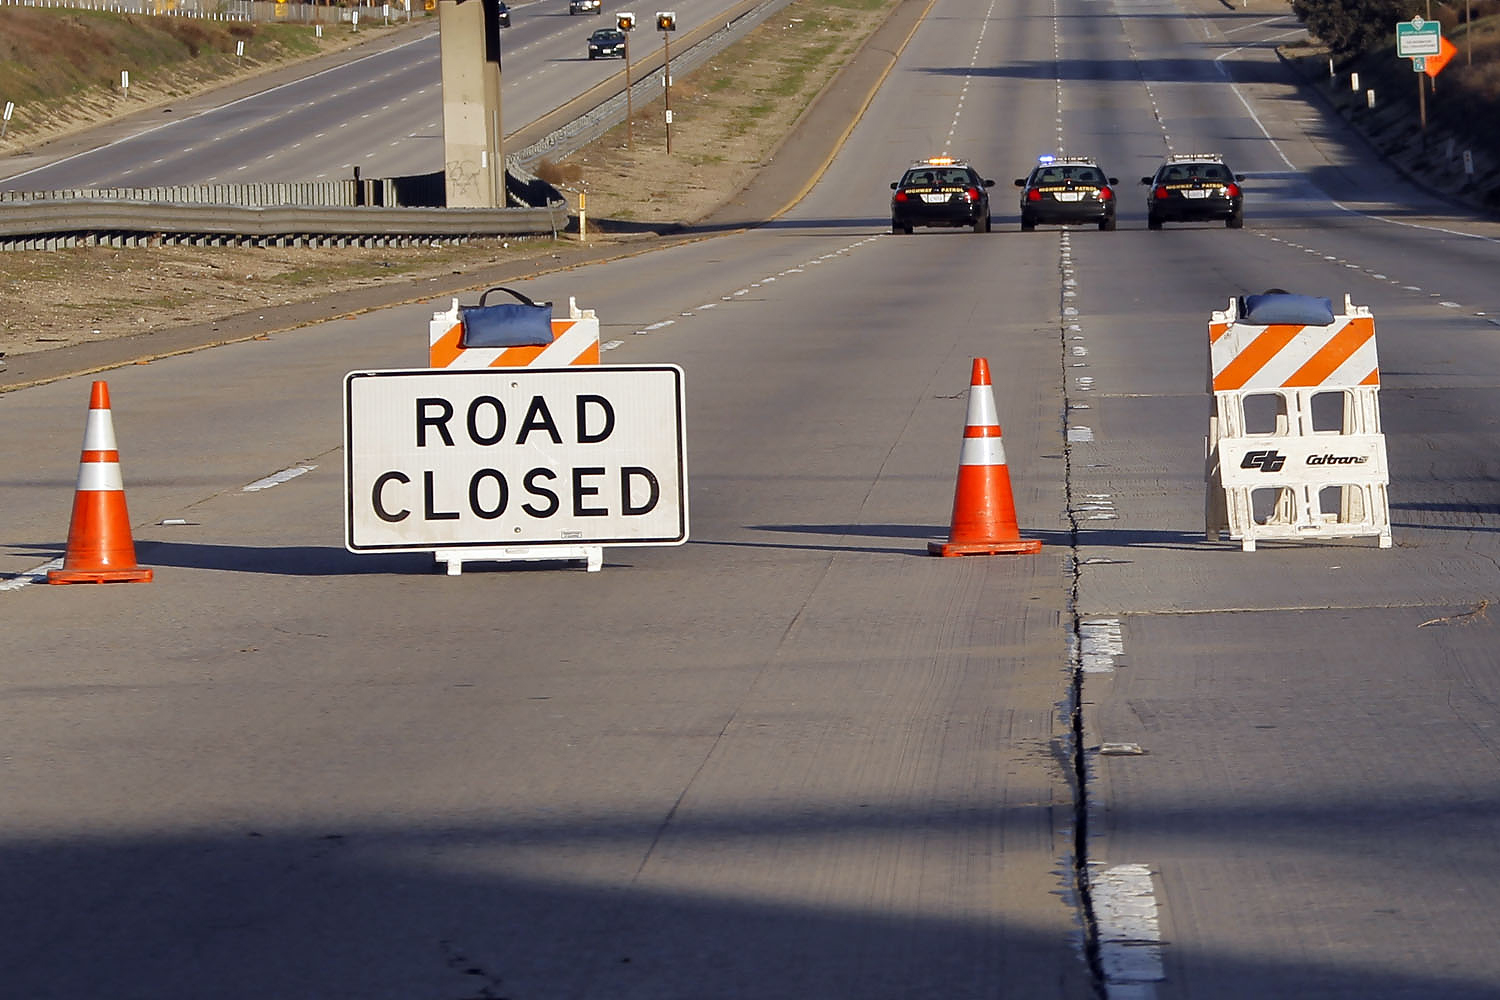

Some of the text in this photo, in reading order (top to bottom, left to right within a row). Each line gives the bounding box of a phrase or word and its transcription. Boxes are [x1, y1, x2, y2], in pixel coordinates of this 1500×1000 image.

[415, 394, 616, 447] ROAD
[1305, 453, 1370, 466] Caltrans
[371, 466, 660, 522] CLOSED
